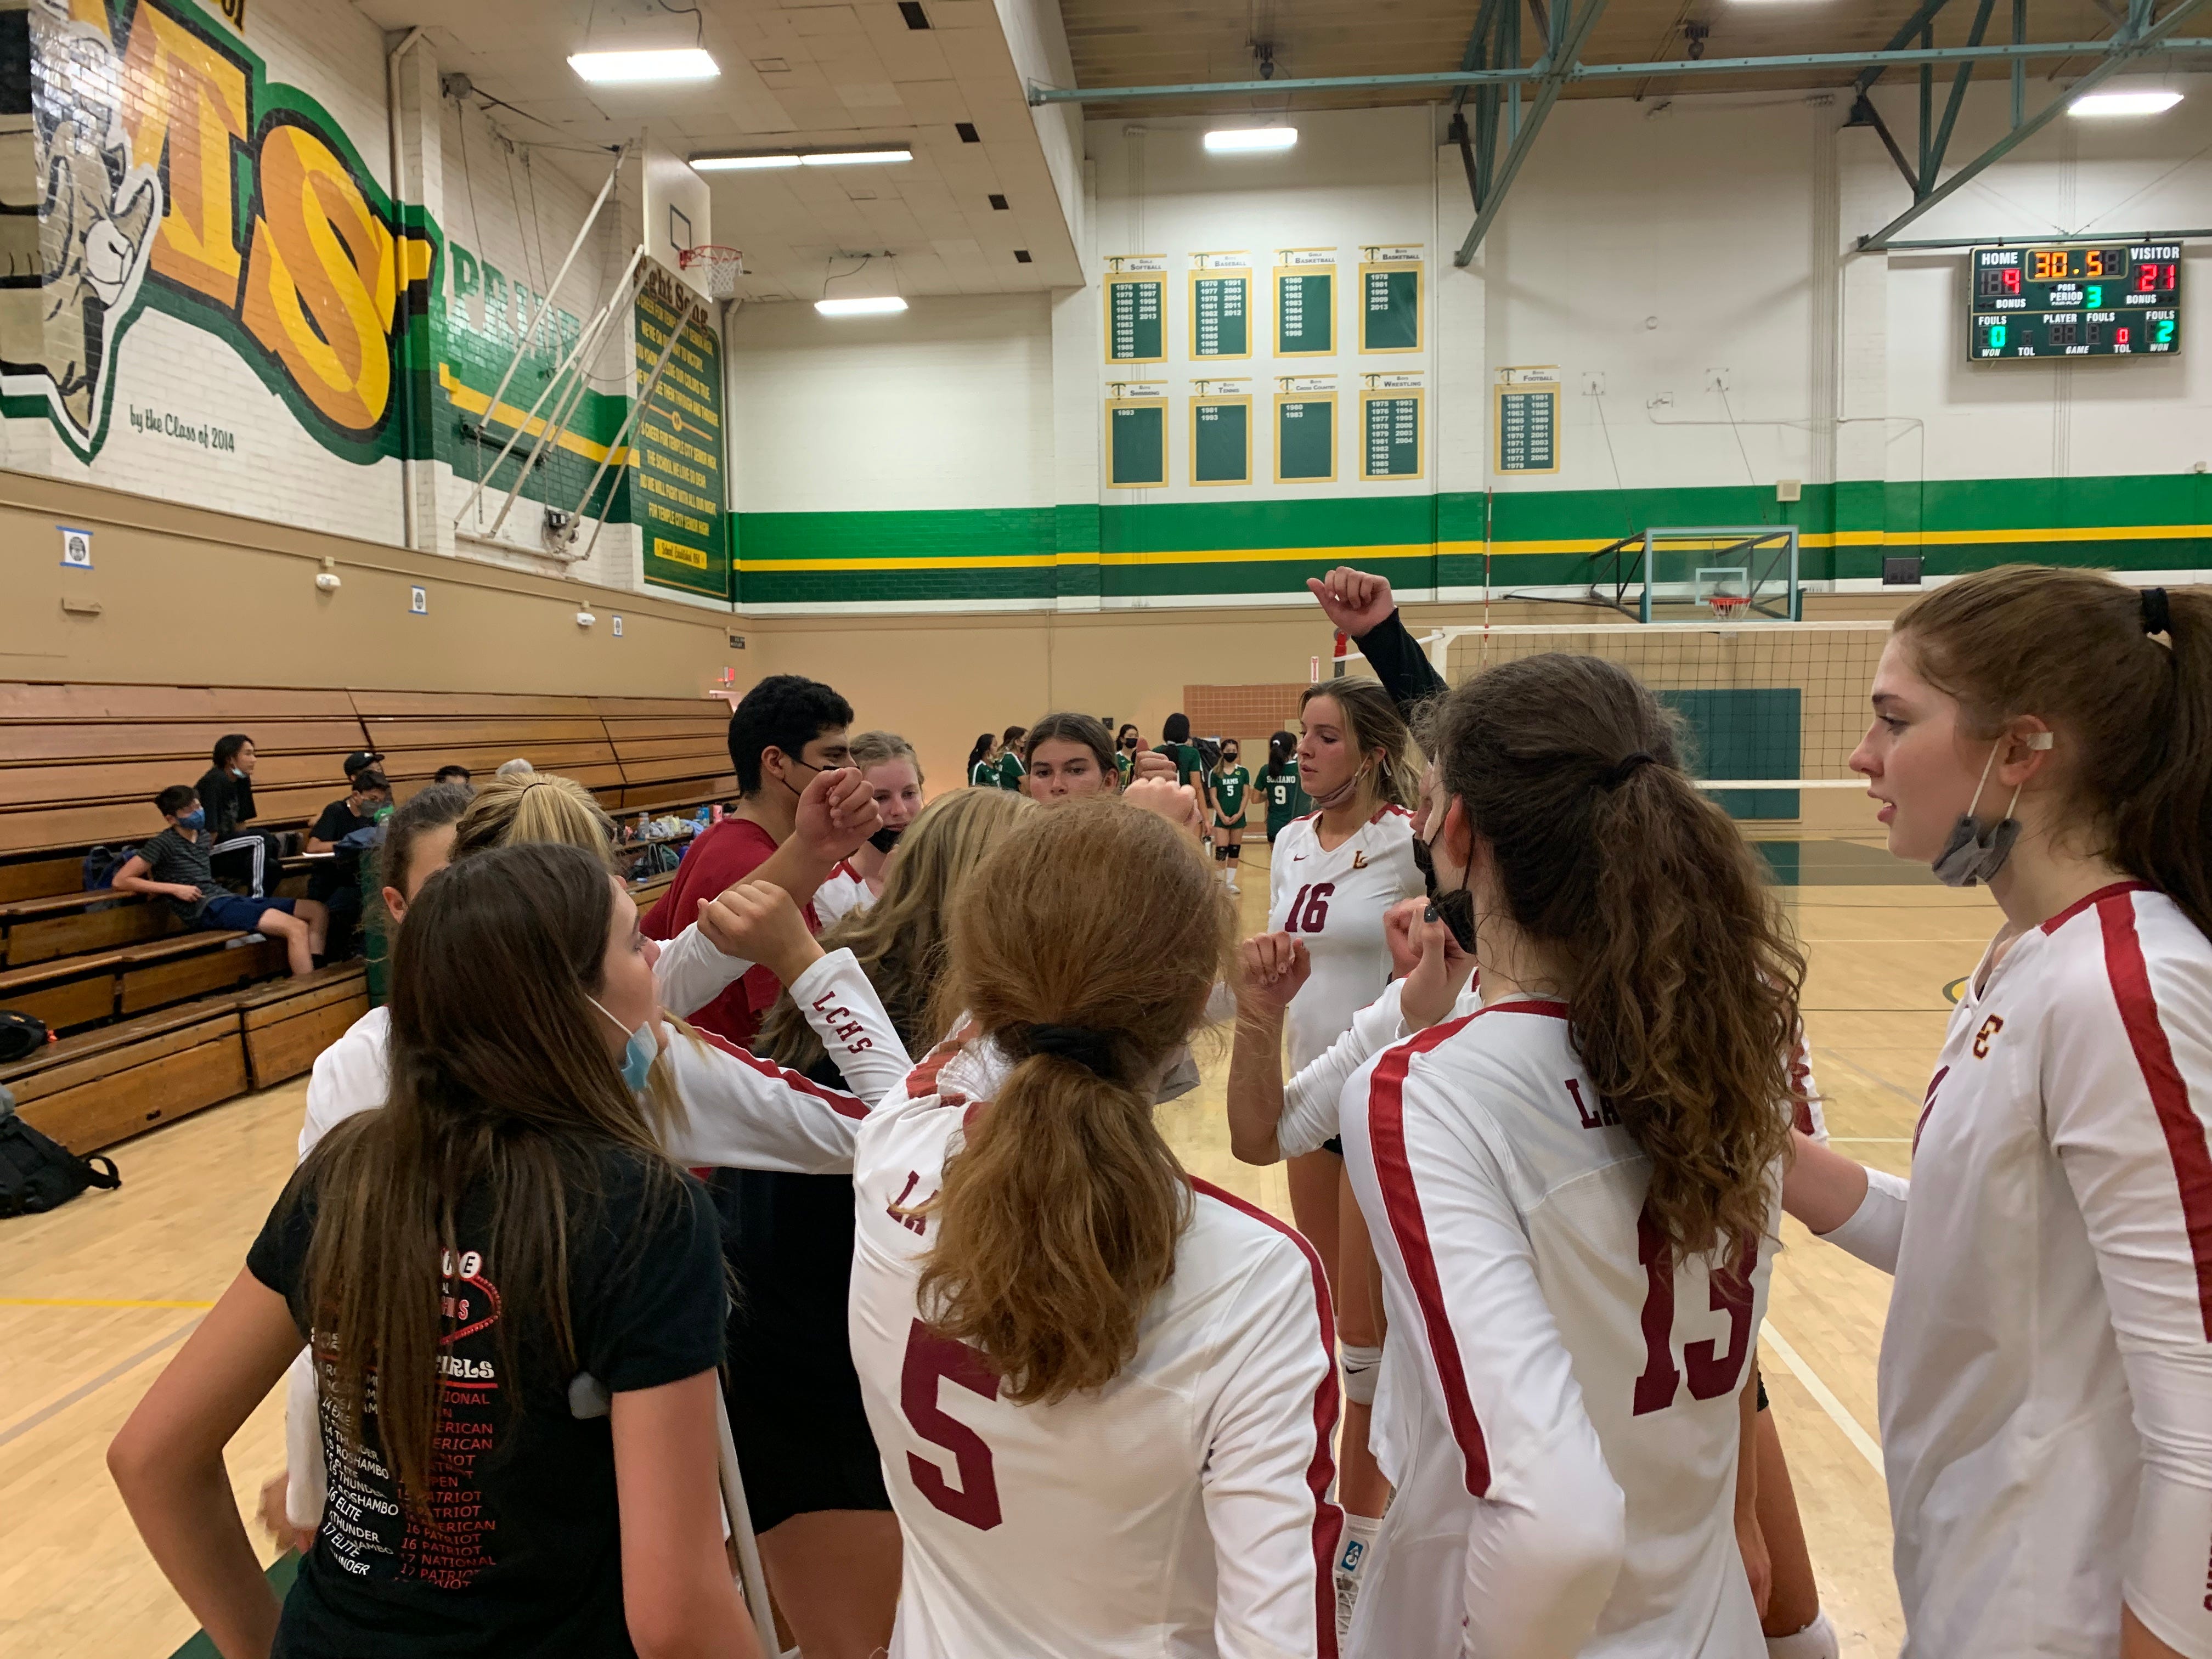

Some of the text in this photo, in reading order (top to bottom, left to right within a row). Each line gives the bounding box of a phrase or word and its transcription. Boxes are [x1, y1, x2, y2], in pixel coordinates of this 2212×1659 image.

[1982, 252, 2018, 265] HOME
[2131, 246, 2180, 260] VISITOR
[2003, 269, 2021, 295] 9
[2140, 264, 2175, 291] 21
[2050, 291, 2083, 301] PERIOD
[2087, 285, 2102, 309] 3
[2126, 294, 2157, 304] BONUS
[1996, 299, 2026, 308] BONUS
[1979, 316, 2007, 325] FOULS
[2044, 313, 2115, 324] PLAYER FOULS
[2146, 311, 2175, 320] FOULS
[1990, 325, 2006, 348] 0
[2117, 328, 2129, 343] 0
[2157, 320, 2174, 343] 2
[2018, 347, 2035, 356] TOL
[2065, 346, 2089, 354] GAME
[2114, 344, 2131, 353] TOL
[130, 404, 234, 453] by the Class of 2014
[1227, 785, 1234, 797] 5
[1274, 786, 1286, 805] 9
[1285, 883, 1335, 933] 16
[812, 991, 873, 1053] LCHS
[436, 1421, 493, 1435] ERICAN
[900, 1318, 1003, 1531] 5
[335, 1430, 379, 1461] THUDER
[433, 1438, 493, 1450] ERICAN
[336, 1444, 389, 1480] ROSHAMBO
[431, 1476, 458, 1487] PEN
[428, 1491, 482, 1504] ATRIOT
[335, 1497, 362, 1522] ELITE
[332, 1511, 380, 1543] THUNDER
[438, 1520, 496, 1532] ERICAN
[331, 1532, 360, 1558] ELITE
[422, 1541, 483, 1556] PATRIOT
[421, 1554, 496, 1567] NATIONAL
